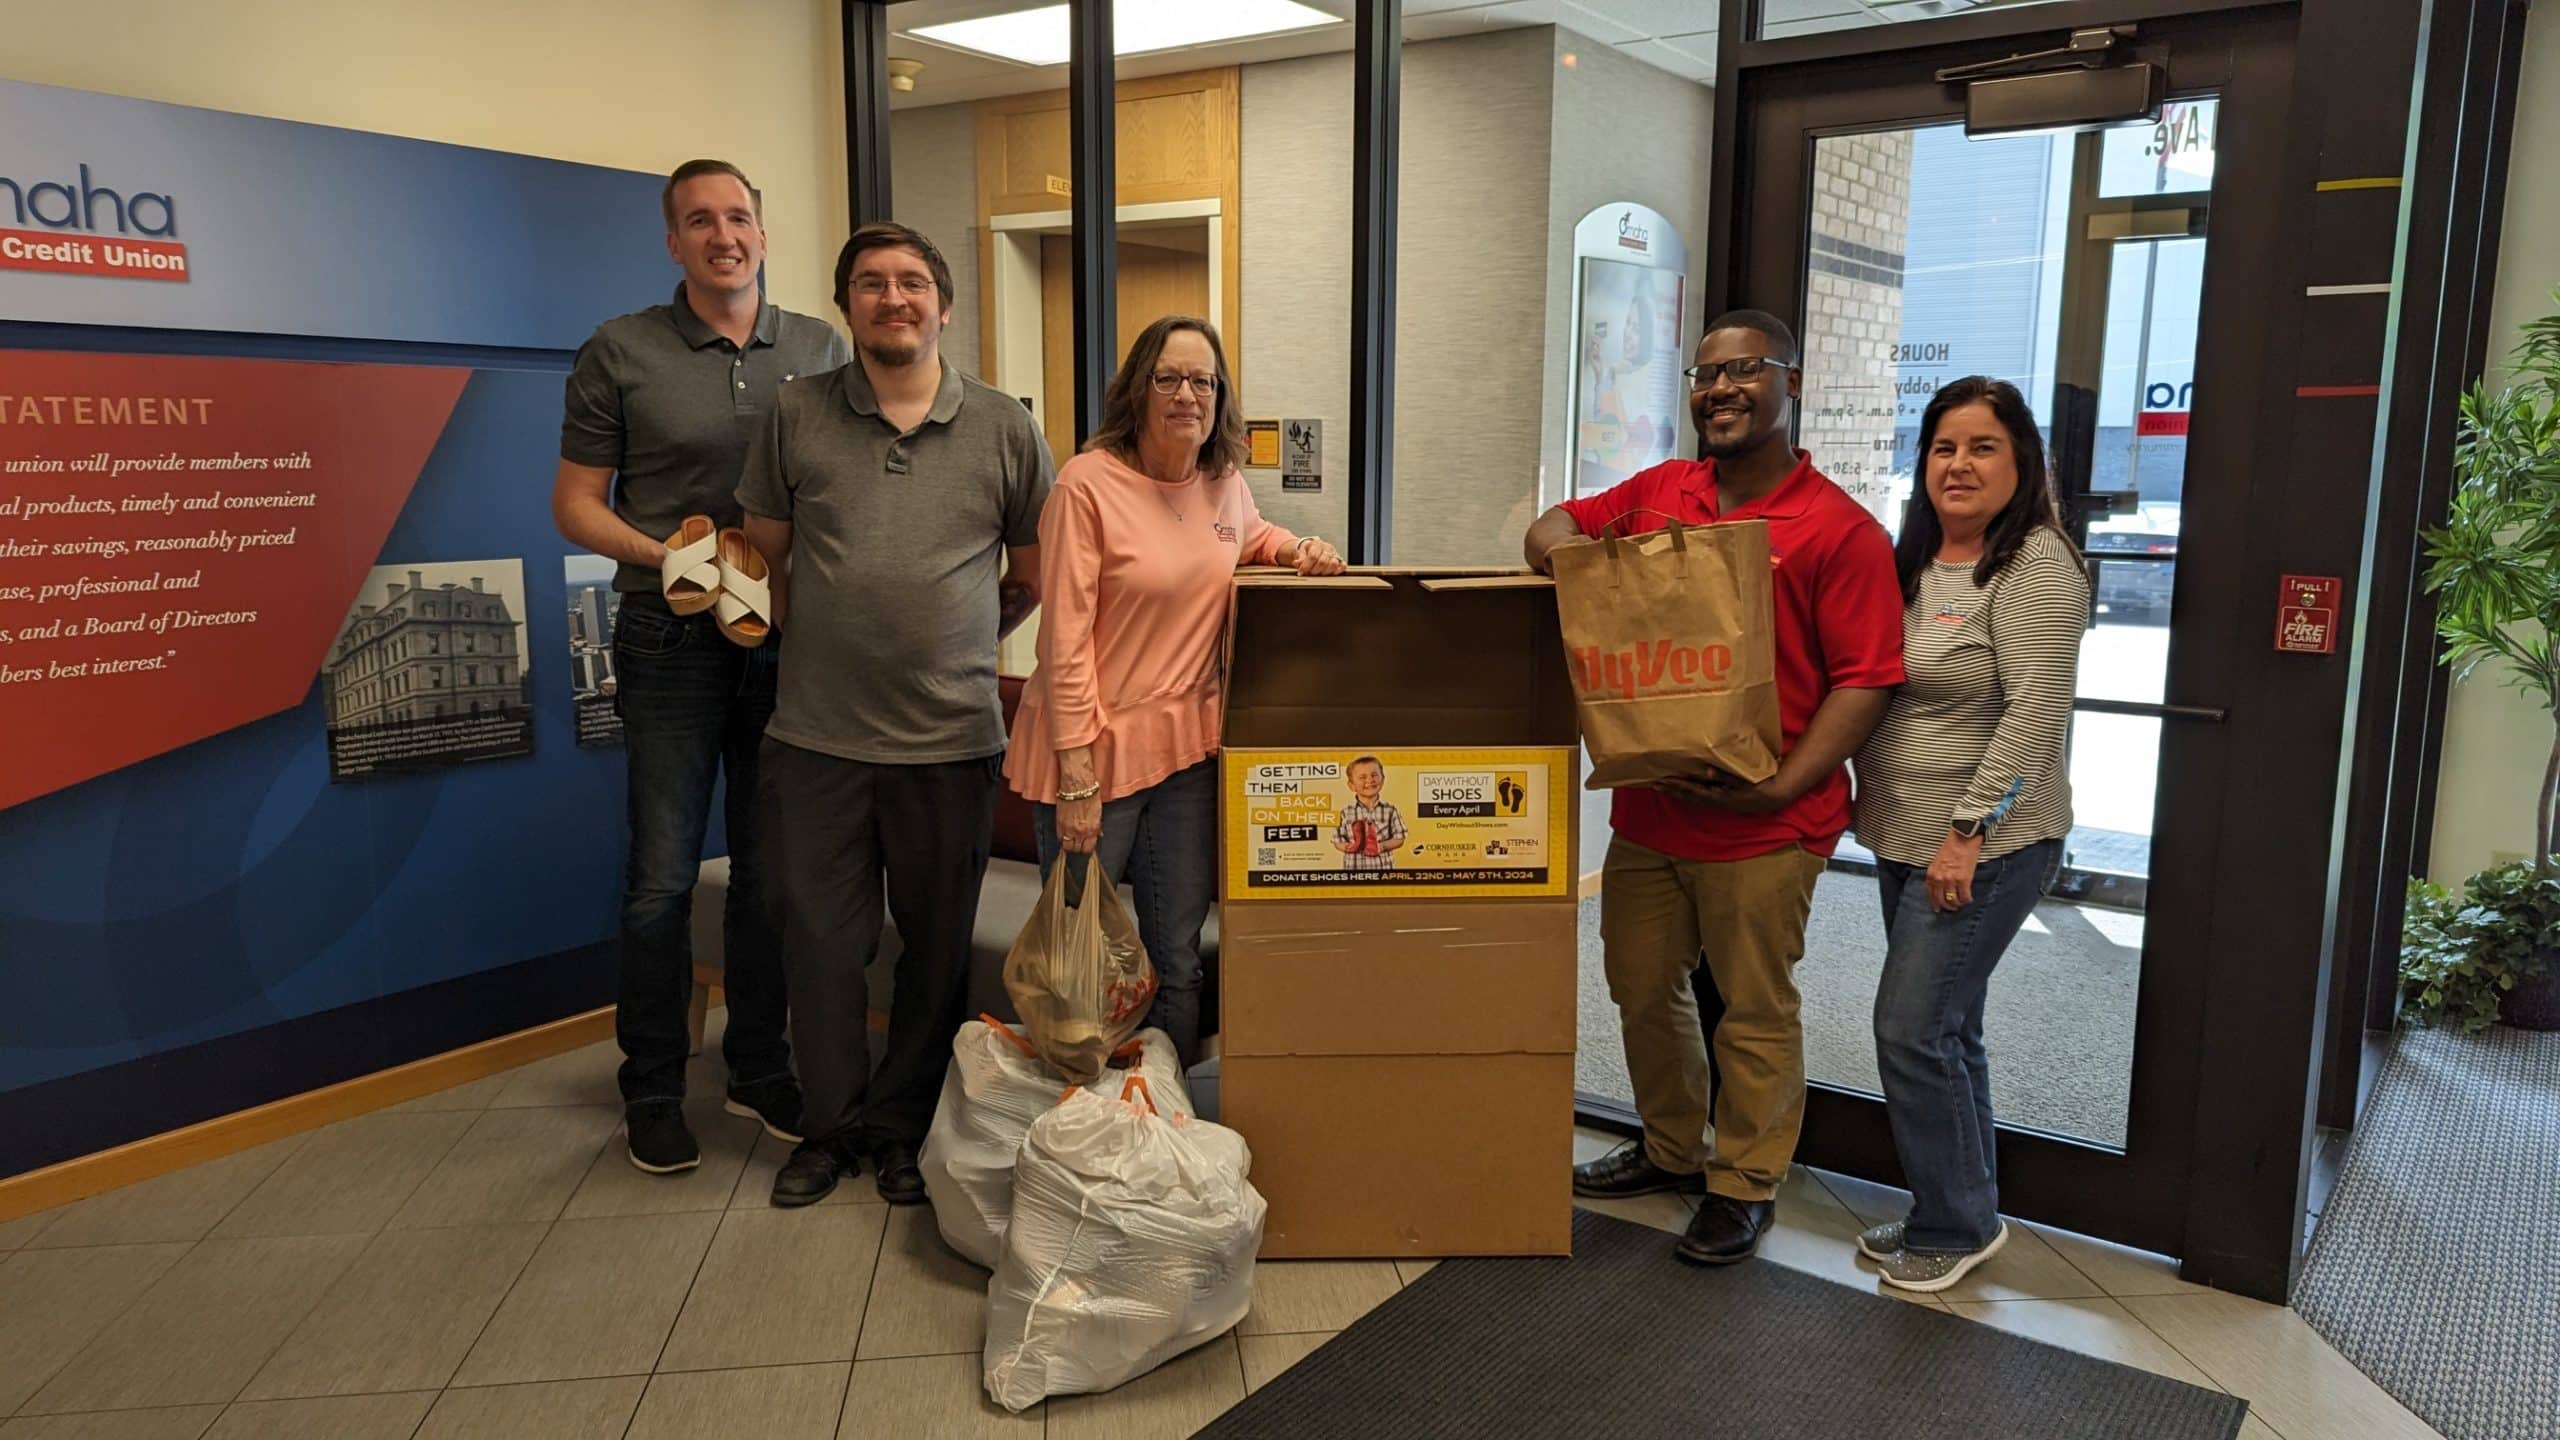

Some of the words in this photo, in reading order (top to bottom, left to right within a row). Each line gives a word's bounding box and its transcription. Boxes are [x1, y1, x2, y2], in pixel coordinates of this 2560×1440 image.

[2, 237, 95, 265] Credit
[103, 244, 186, 271] Union
[5, 454, 65, 473] union
[70, 453, 110, 472] will
[110, 451, 186, 478] provide
[189, 452, 269, 470] members
[273, 451, 313, 470] with
[22, 494, 117, 521] products,
[121, 492, 181, 516] timely
[183, 491, 221, 511] and
[223, 490, 317, 509] convenient
[0, 538, 49, 558] their
[51, 536, 130, 559] savings,
[135, 529, 237, 553] reasonably
[238, 527, 297, 553] priced
[38, 572, 161, 604] professional
[163, 570, 201, 589] and
[2296, 583, 2322, 592] PULL
[19, 619, 60, 641] and
[65, 621, 78, 637] a
[83, 612, 146, 636] Board
[150, 610, 175, 635] of
[174, 608, 258, 630] Directors
[2283, 623, 2327, 637] FIRE
[2285, 634, 2323, 643] ALARM
[49, 660, 88, 680] best
[1260, 764, 1337, 778] GETTING
[1248, 782, 1298, 794] THEM
[1431, 788, 1483, 801] SHOES
[1280, 796, 1328, 808] BACK
[1433, 805, 1458, 816] Every
[1459, 804, 1481, 815] April
[1254, 810, 1280, 823] ON
[1283, 811, 1336, 825] THEIR
[1267, 826, 1313, 840] FEET
[1263, 873, 1309, 882] DONATE
[1309, 872, 1349, 881] SHOES
[1349, 872, 1380, 881] HERE
[1381, 872, 1414, 881] APRIL
[1453, 872, 1477, 880] MAY
[1503, 871, 1534, 880] 2024
